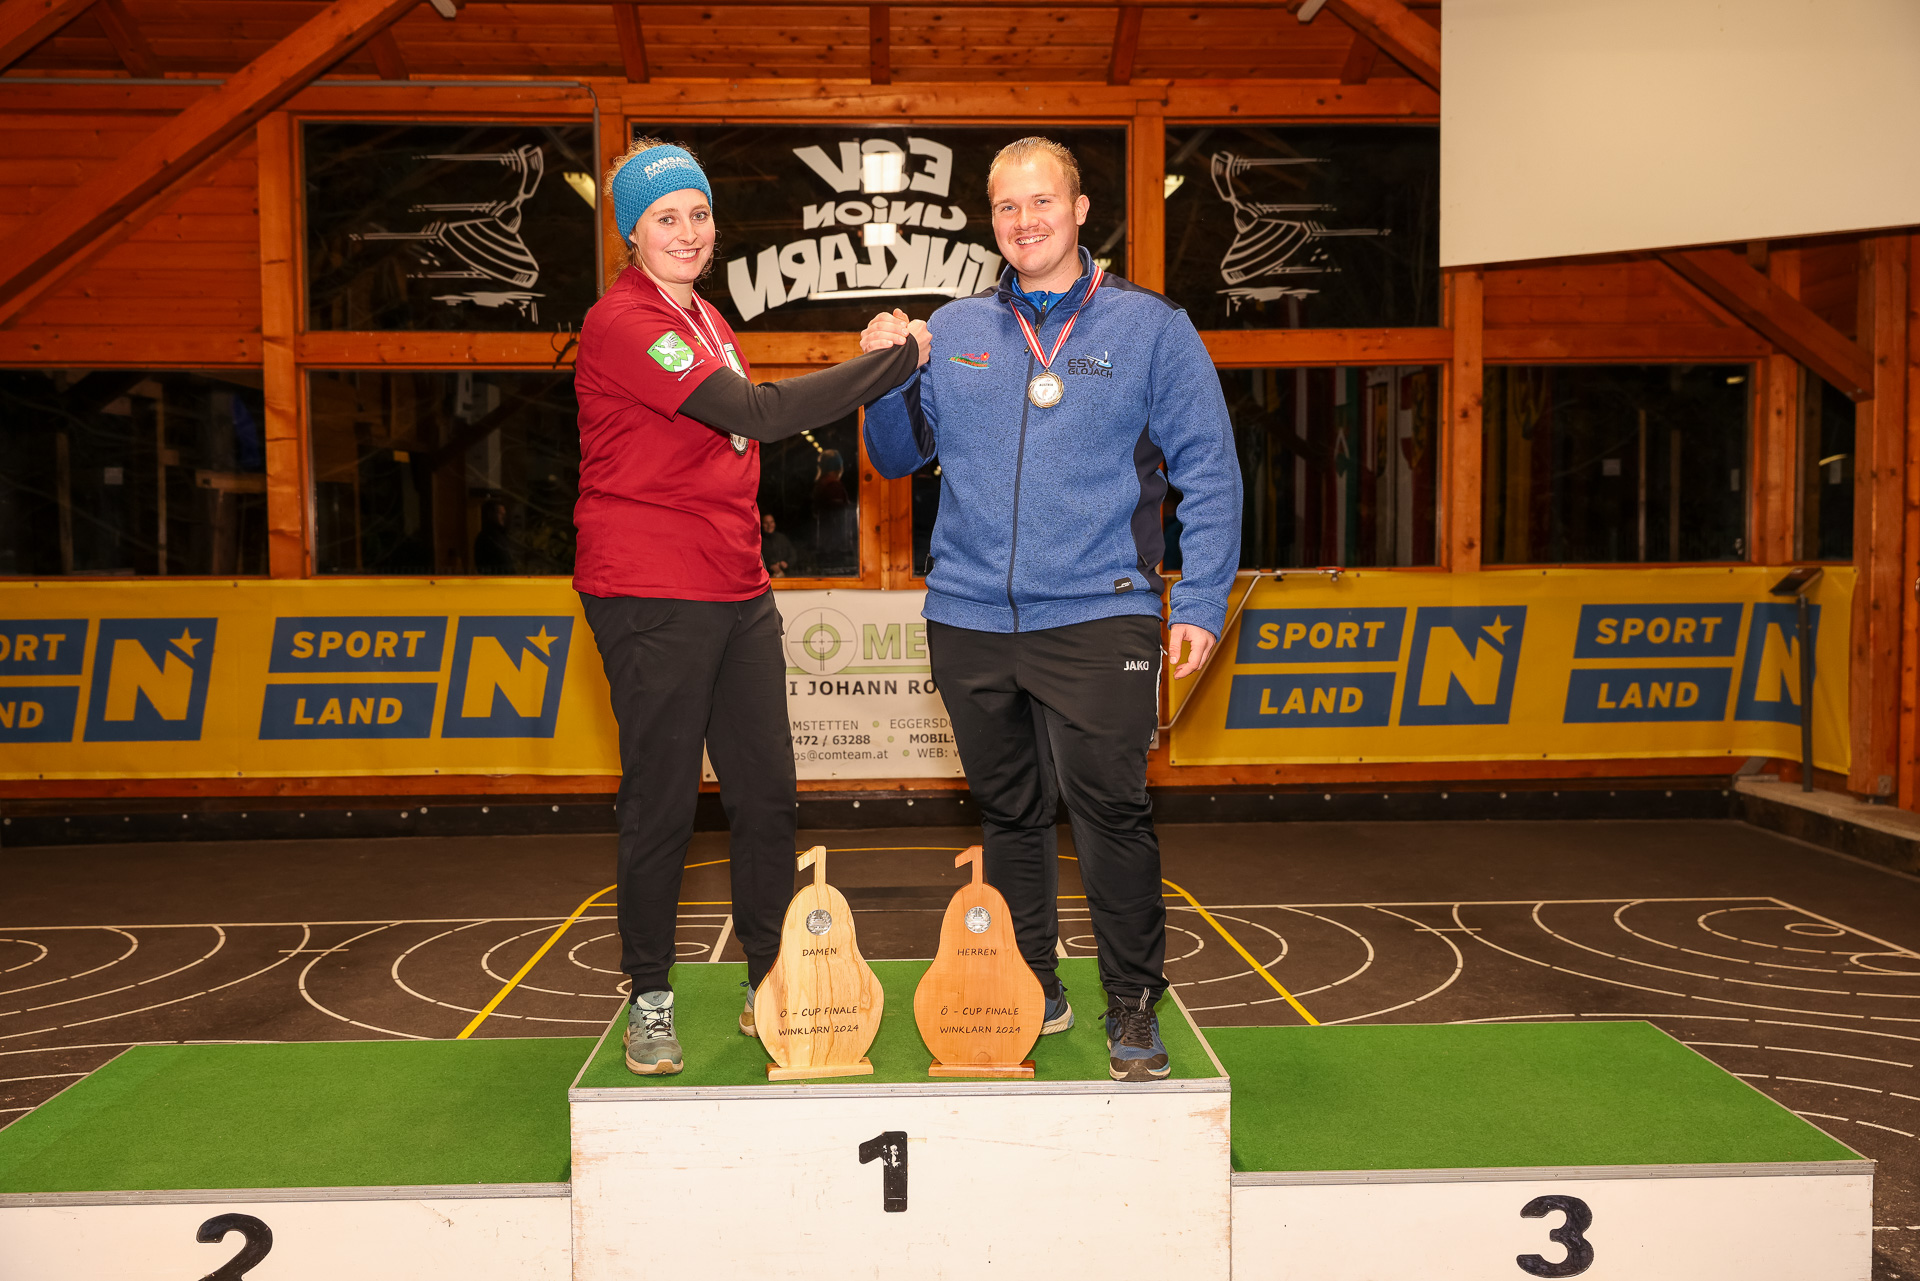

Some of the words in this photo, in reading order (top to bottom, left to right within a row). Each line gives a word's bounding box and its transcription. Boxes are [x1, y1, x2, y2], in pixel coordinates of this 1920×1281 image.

[1068, 359, 1096, 368] ESV
[1068, 368, 1113, 379] GLOJACH
[1257, 621, 1385, 650] SPORT
[1595, 617, 1723, 645] SPORT
[290, 630, 427, 659] SPORT
[1124, 660, 1149, 671] JAKO
[807, 680, 898, 696] JOHANN
[1259, 687, 1364, 715] LAND
[1597, 682, 1700, 709] LAND
[294, 697, 403, 726] LAND
[791, 720, 859, 731] MSTETTEN
[832, 734, 871, 745] 63288
[909, 733, 954, 743] MOBIL:
[917, 748, 948, 758] WEB:
[802, 947, 837, 957] DAMEN
[957, 948, 997, 957] HERREN
[780, 1008, 788, 1018] Ö
[801, 1008, 821, 1017] CUP
[824, 1005, 858, 1015] FINALE
[940, 1005, 948, 1016] Ö
[962, 1007, 982, 1016] CUP
[985, 1007, 1020, 1016] FINALE
[778, 1026, 830, 1036] WINKLARN
[834, 1024, 859, 1033] 2024
[940, 1026, 992, 1034] WINKLARN
[995, 1026, 1021, 1034] 2024
[858, 1131, 907, 1212] 1
[1516, 1195, 1594, 1278] 3
[197, 1214, 273, 1281] 2
